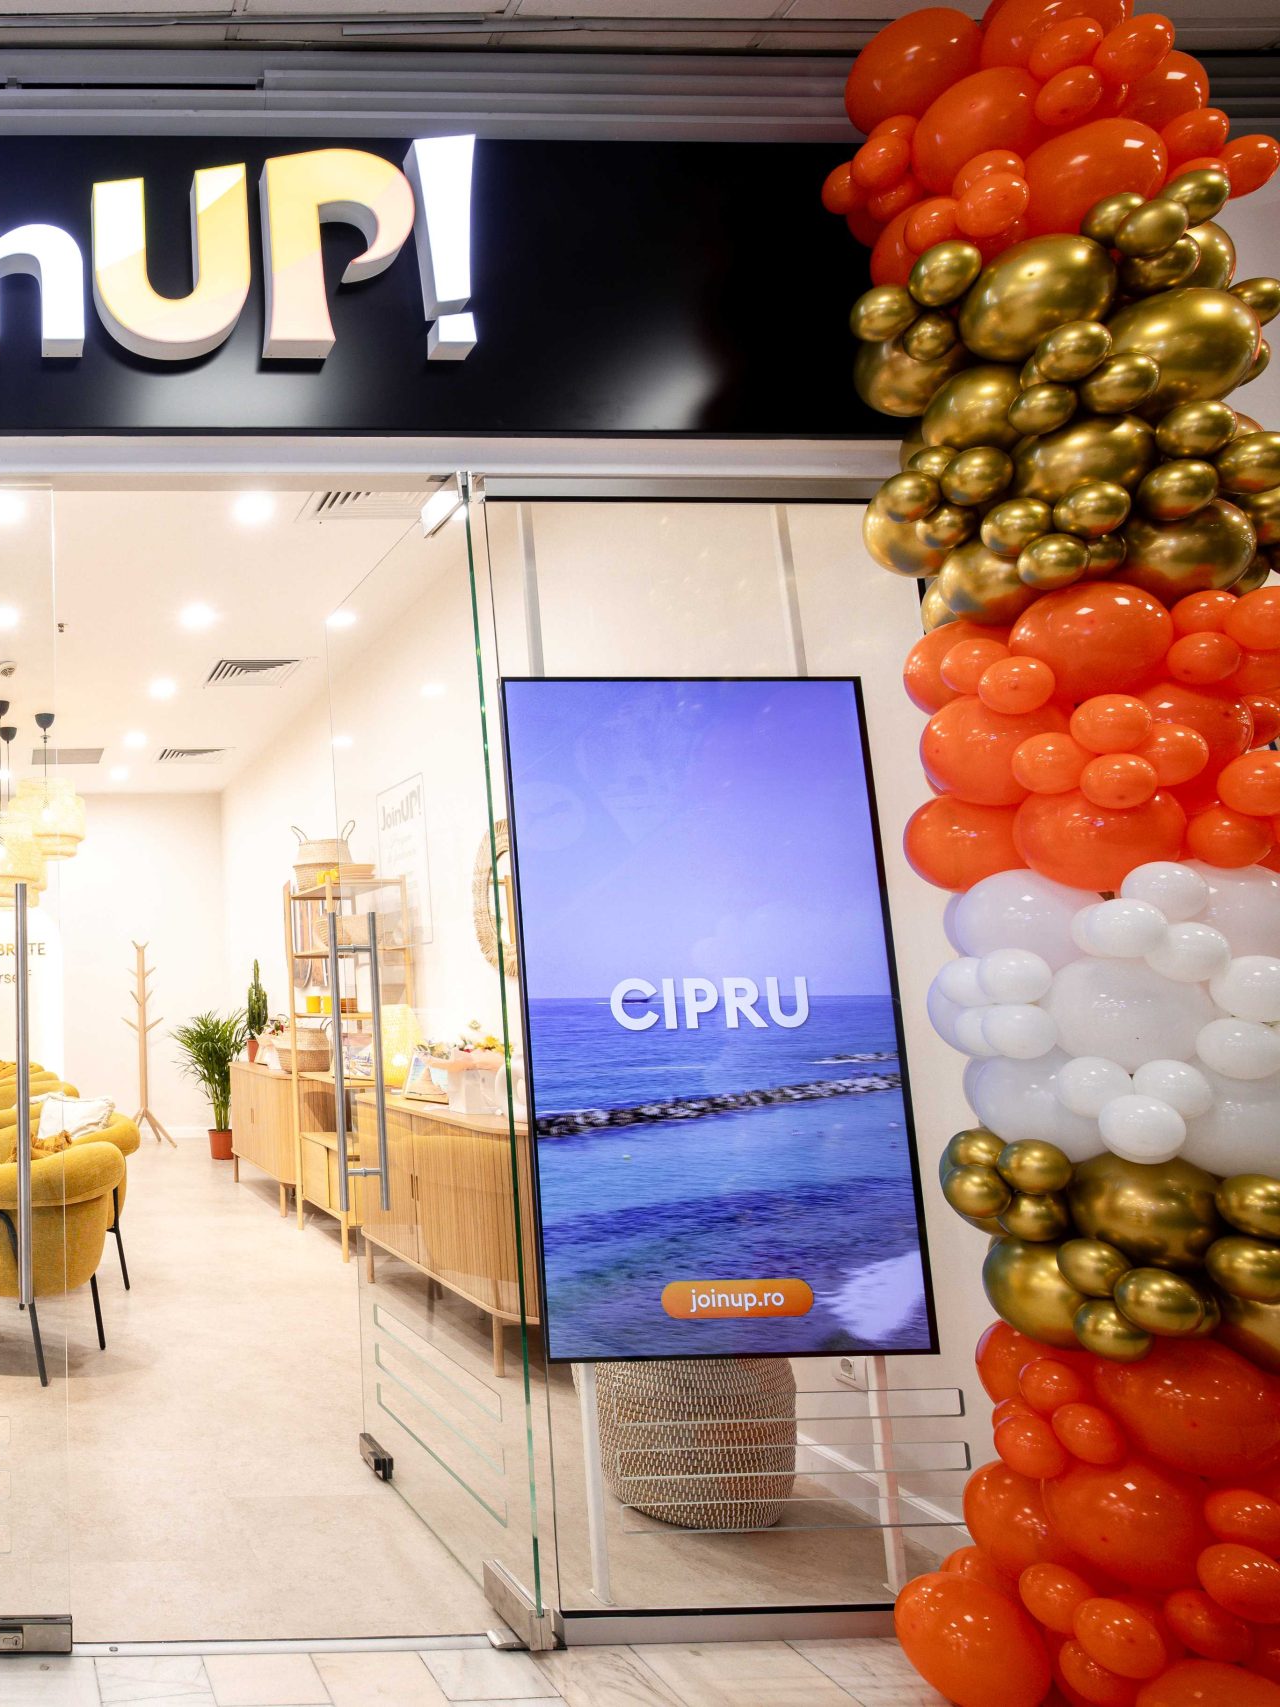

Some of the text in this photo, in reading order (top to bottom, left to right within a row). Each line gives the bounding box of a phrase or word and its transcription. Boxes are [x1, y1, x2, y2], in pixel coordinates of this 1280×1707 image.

[381, 785, 423, 831] JoinUP!
[609, 975, 811, 1031] CIPRU
[690, 1288, 785, 1313] joinup.ro
